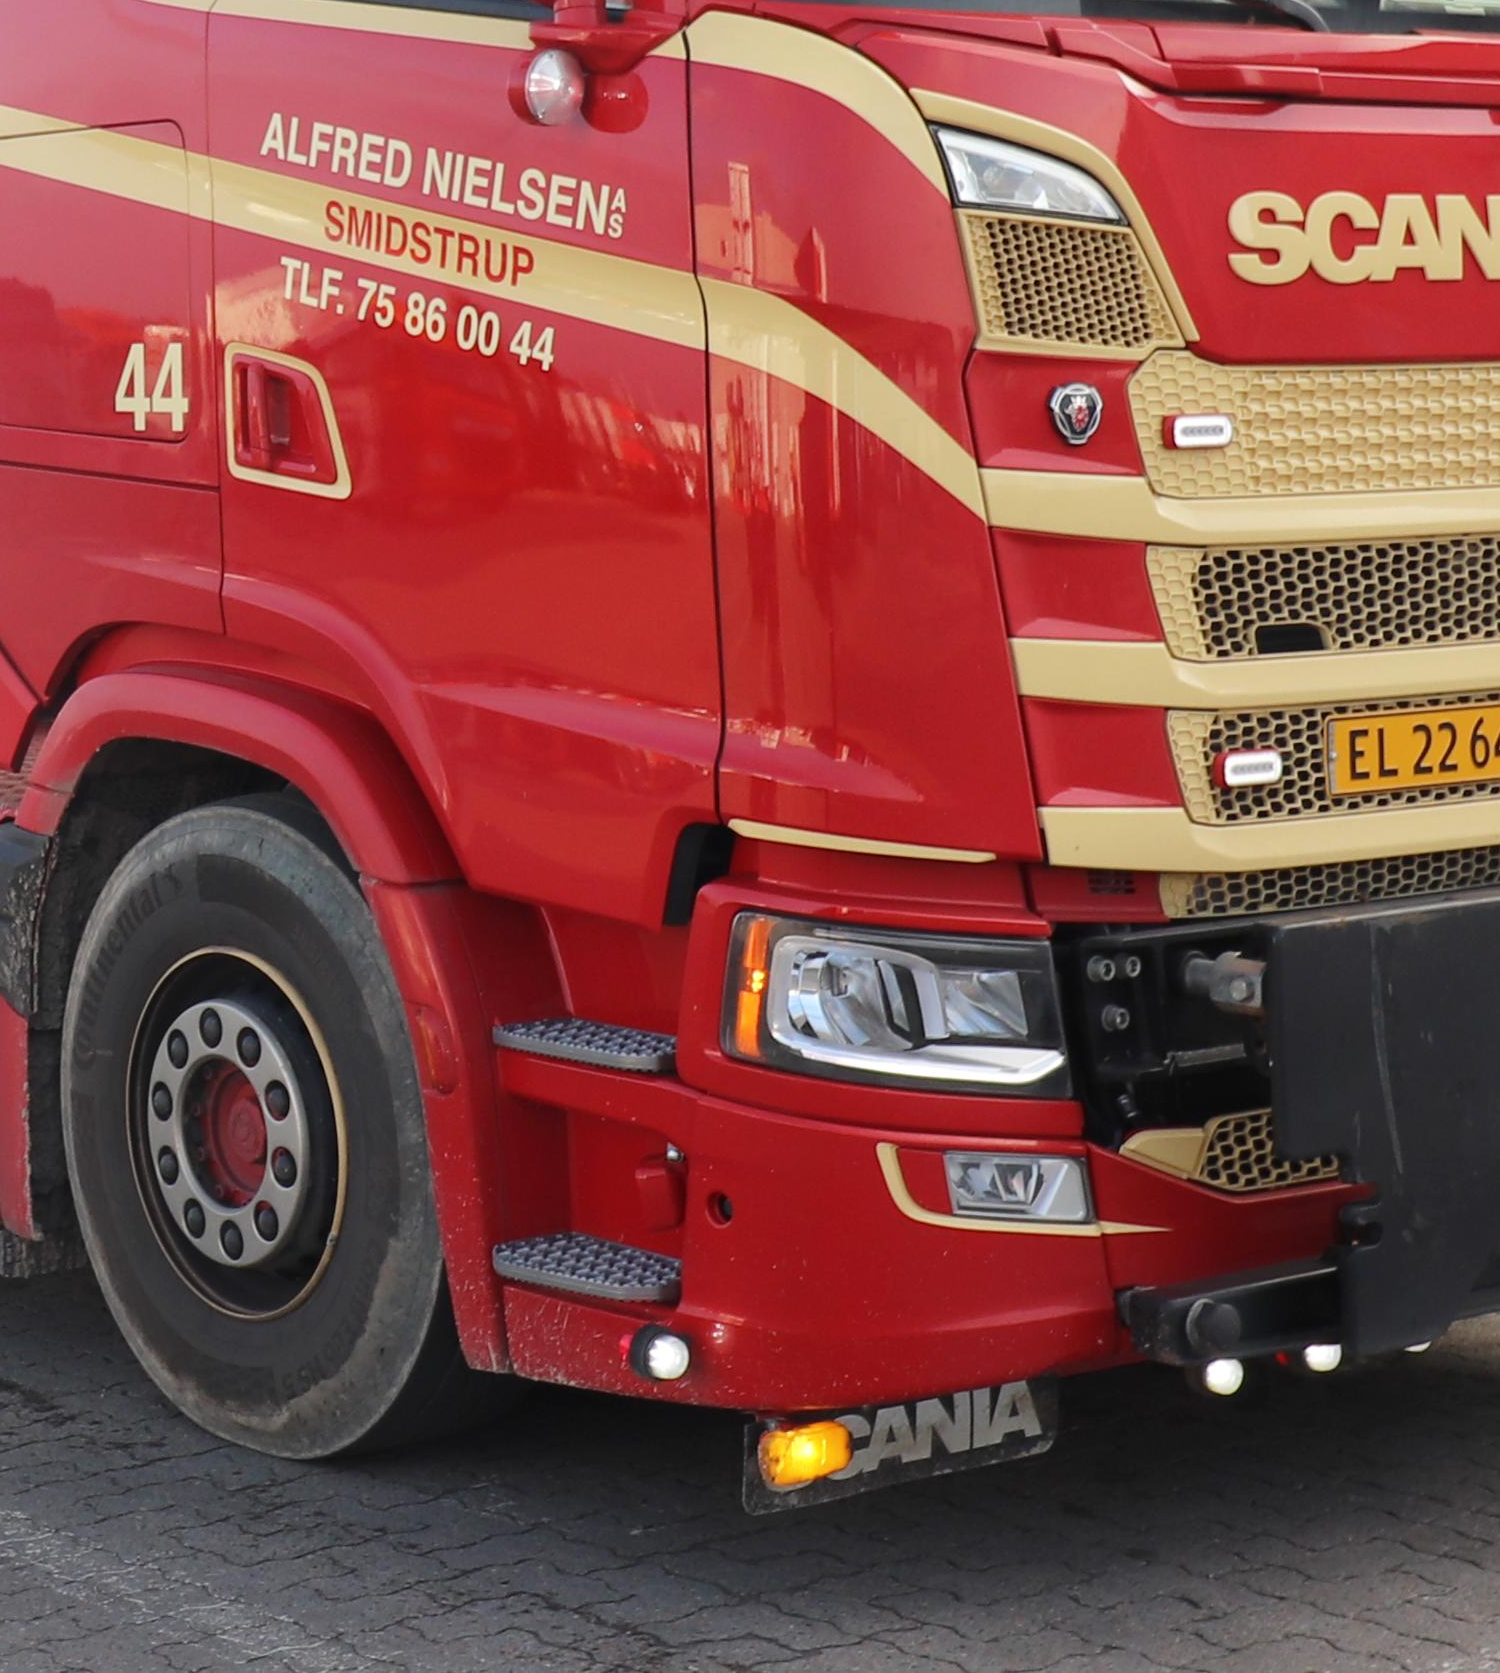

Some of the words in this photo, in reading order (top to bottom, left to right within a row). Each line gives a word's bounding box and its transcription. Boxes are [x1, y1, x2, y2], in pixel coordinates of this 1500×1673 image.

[260, 113, 413, 188] ALFRED
[422, 147, 610, 236] NIELSEN
[324, 200, 535, 287] SMIDSTRUP
[280, 256, 344, 315] TLF.
[357, 278, 396, 328] 75
[404, 292, 447, 342] 86
[456, 305, 500, 356] 00
[509, 320, 554, 372] 44
[114, 342, 189, 432] 44
[1349, 727, 1398, 780] EL
[1412, 722, 1458, 776] 22
[770, 1379, 1043, 1493] CANIA
